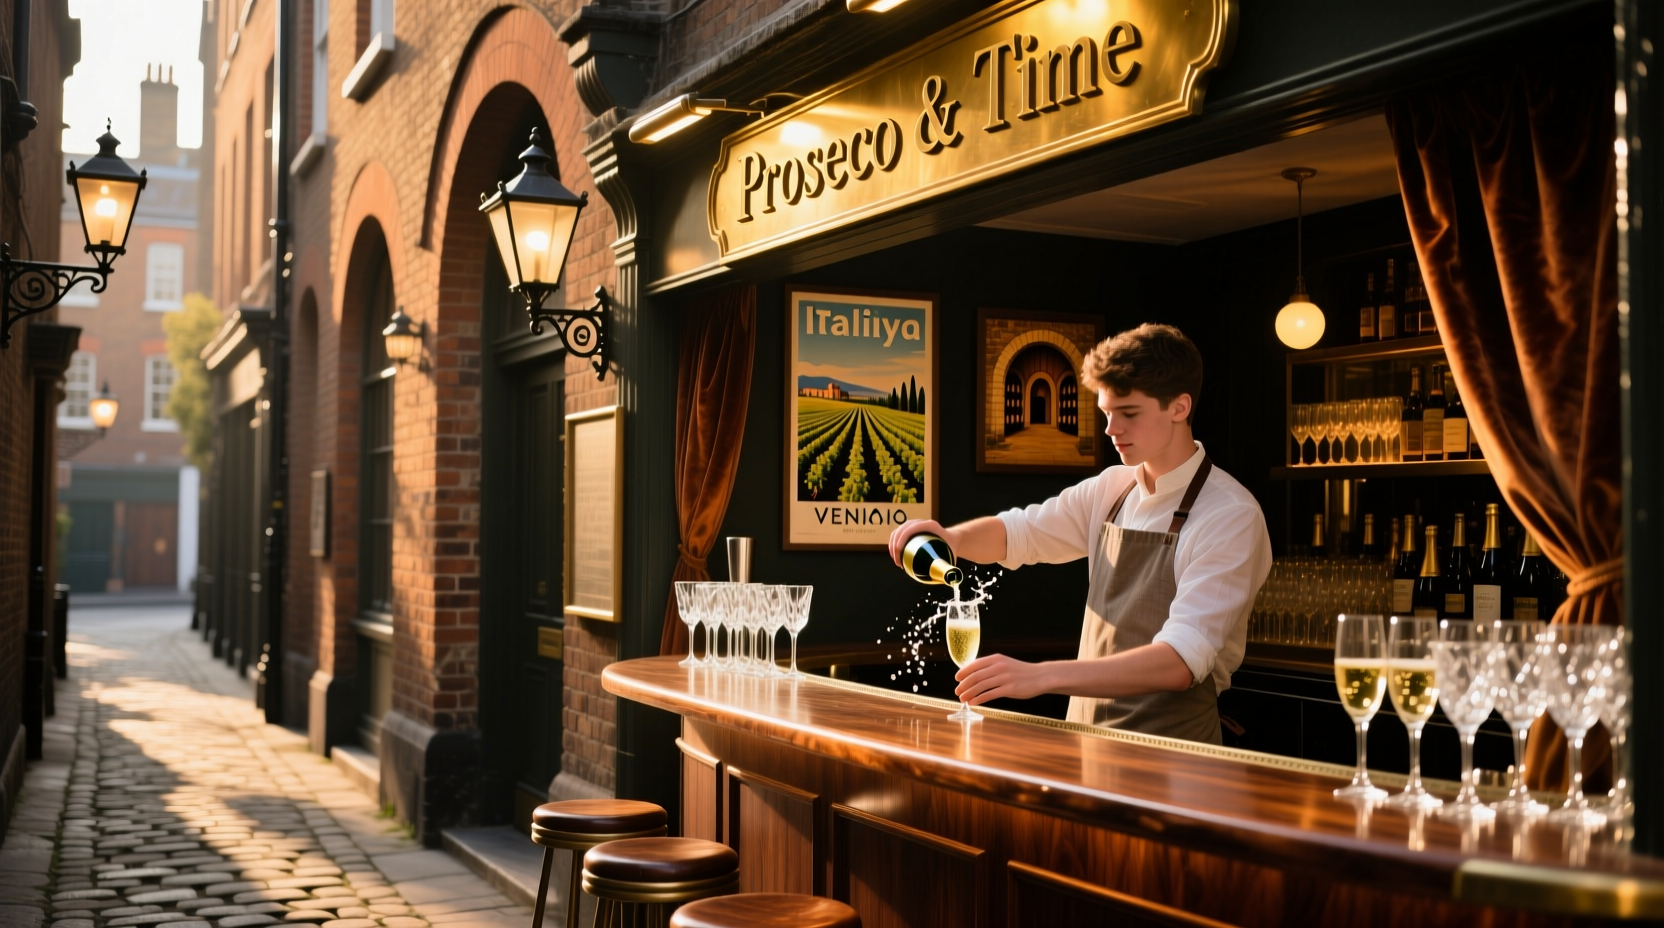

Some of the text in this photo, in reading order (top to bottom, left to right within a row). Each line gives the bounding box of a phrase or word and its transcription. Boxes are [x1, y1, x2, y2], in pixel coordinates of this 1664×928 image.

[737, 20, 1142, 223] Proseco & Time
